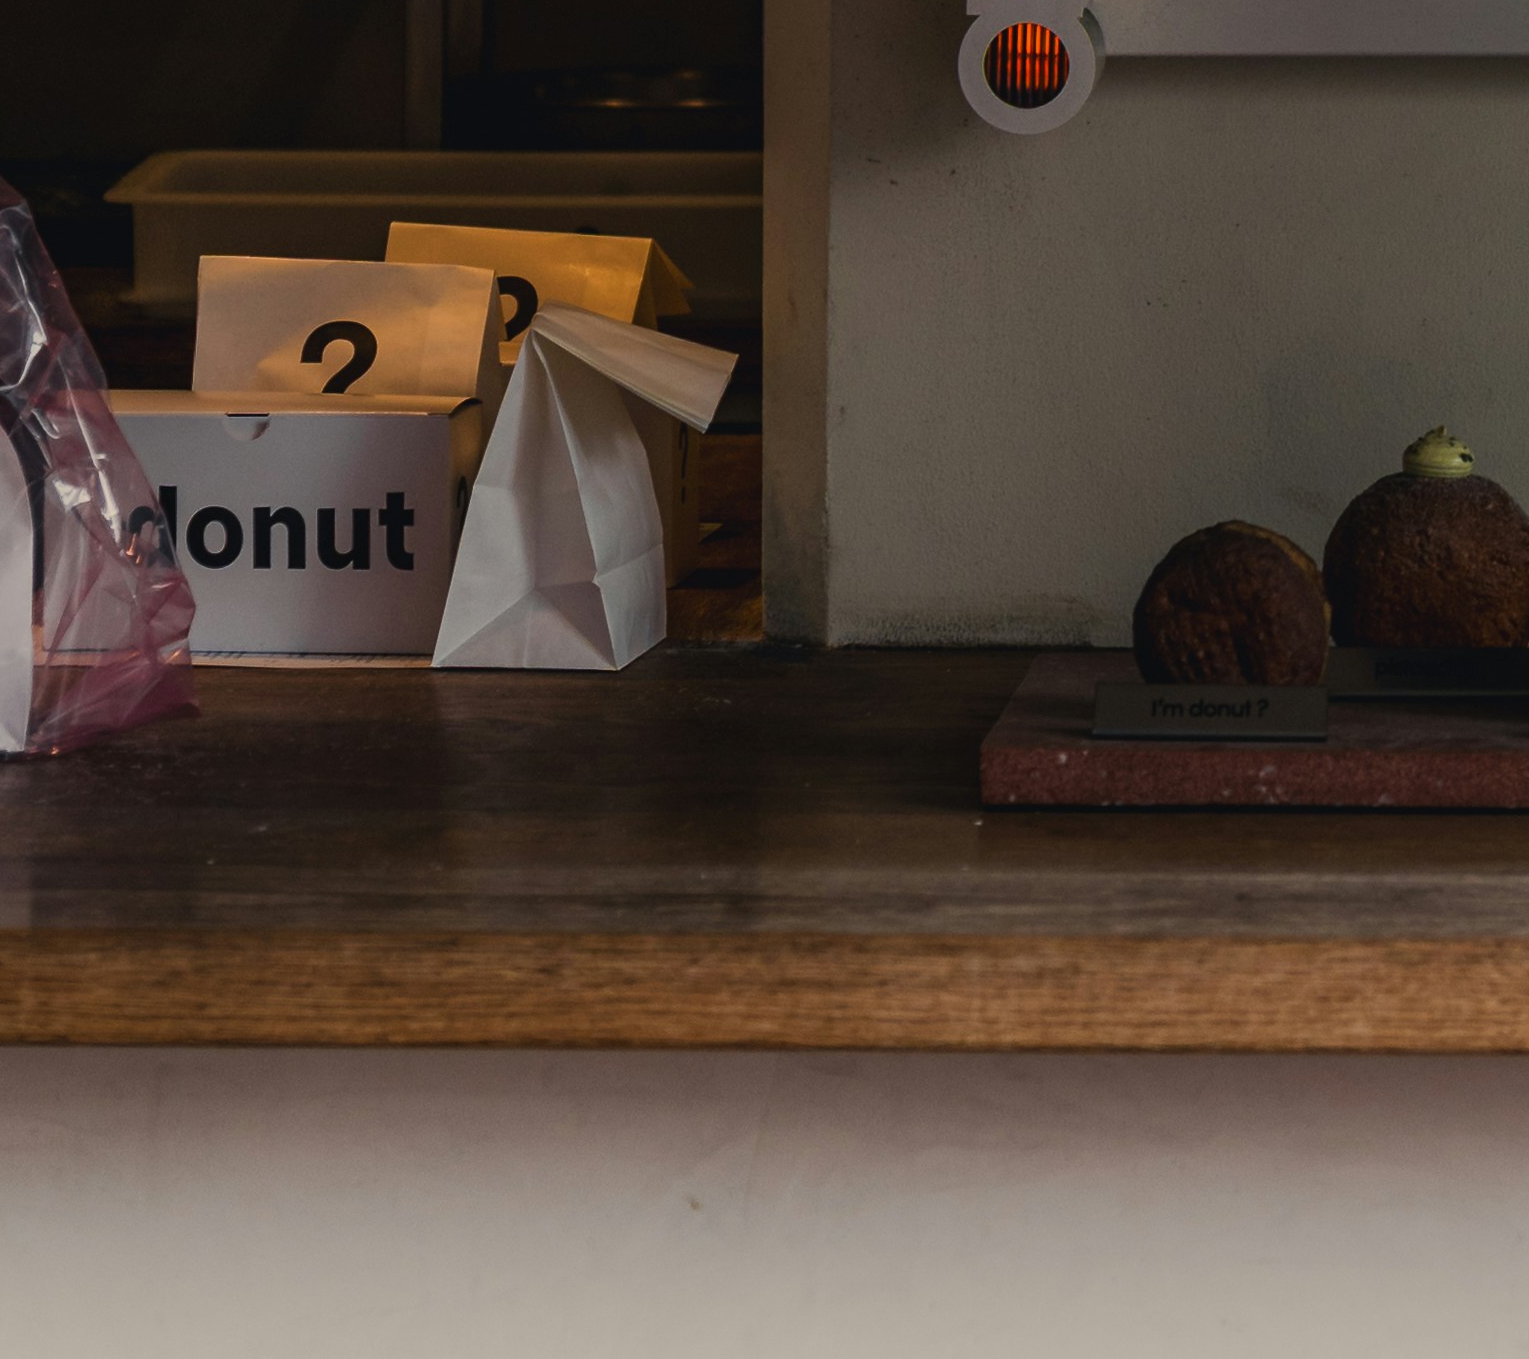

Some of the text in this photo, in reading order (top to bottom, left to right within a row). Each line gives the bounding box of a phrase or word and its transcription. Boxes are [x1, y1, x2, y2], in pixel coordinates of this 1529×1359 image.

[127, 484, 415, 571] donut
[1151, 698, 1269, 717] I'm donut ?
